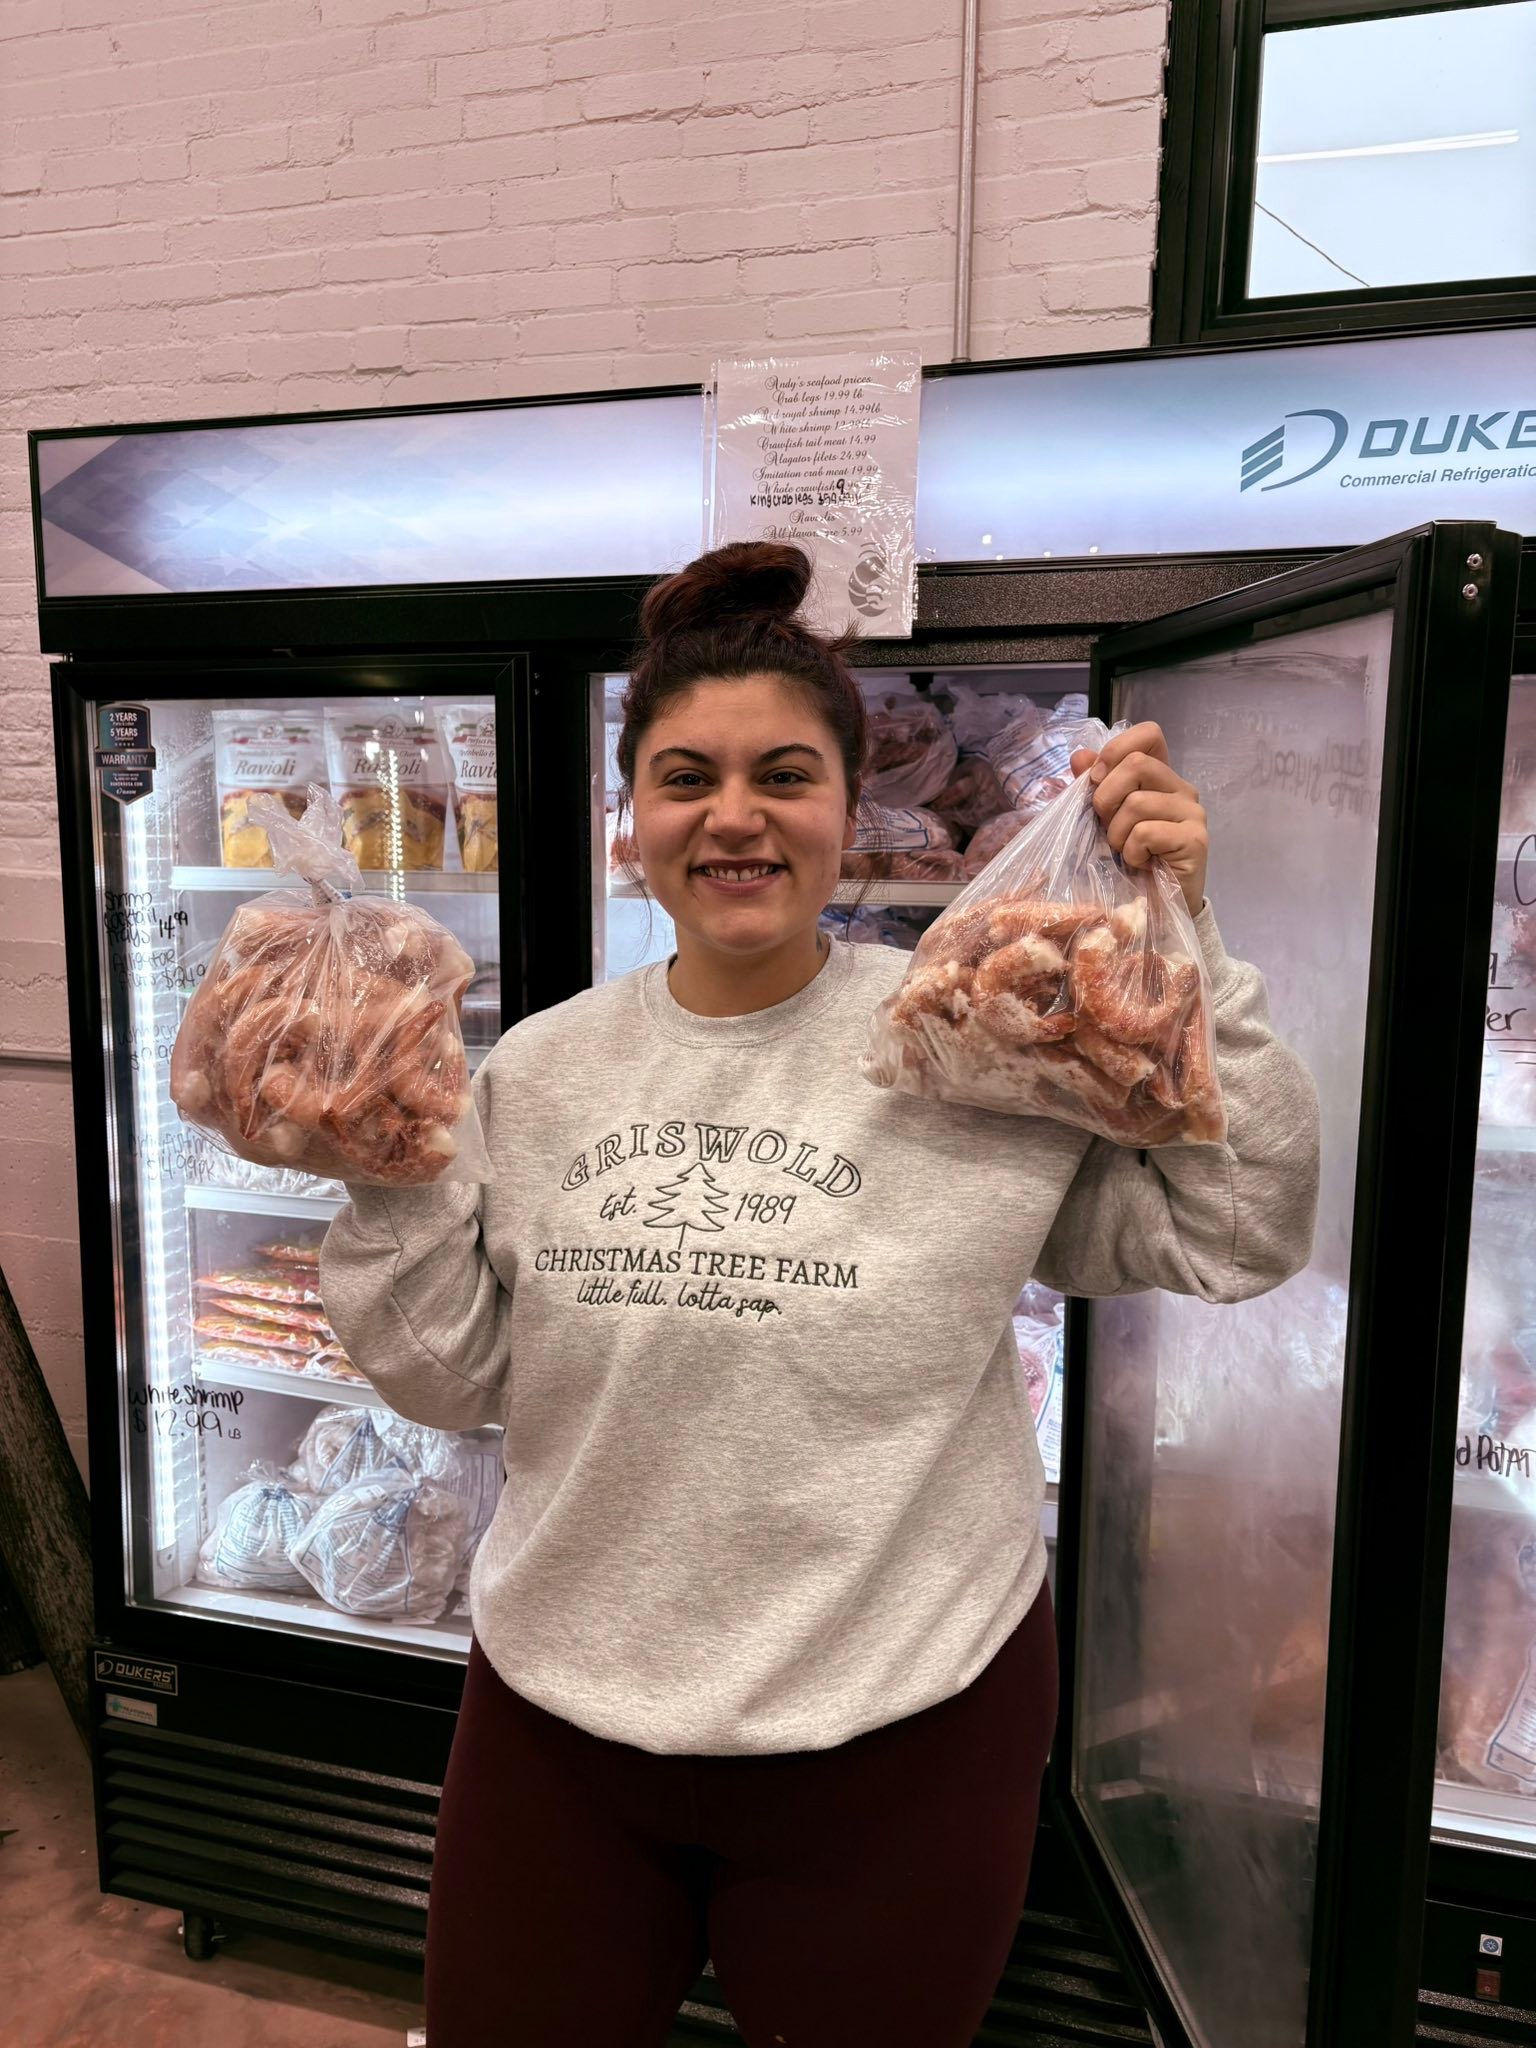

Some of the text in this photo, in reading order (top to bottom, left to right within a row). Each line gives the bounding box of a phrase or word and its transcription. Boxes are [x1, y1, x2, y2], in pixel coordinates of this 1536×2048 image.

[764, 375, 871, 392] Andy's seafood prices
[772, 388, 864, 405] Crab legs 19.99 lb
[782, 407, 807, 420] royal
[809, 405, 841, 420] shrimp
[763, 422, 797, 435] White
[799, 422, 831, 434] shrimp
[757, 434, 876, 452] Crawfish tail meat 14.99
[764, 450, 868, 466] Alagator filets 24.99
[752, 465, 879, 481] Imitation crab meat 19.99
[1339, 468, 1439, 488] Commercial
[757, 481, 794, 495] Whole
[795, 480, 836, 495] crawfish
[794, 492, 814, 506] legs
[762, 524, 786, 540] All
[788, 526, 822, 541] flavor
[840, 526, 863, 537] 5.99
[110, 712, 138, 722] 2 YEARS
[110, 728, 138, 737] 5 YEARS
[101, 754, 148, 765] WARRANTY
[234, 759, 296, 777] Ravioli
[353, 758, 421, 776] Raoli
[561, 1121, 862, 1199] GRISWOLD
[599, 1186, 797, 1225] Est. 1989
[534, 1248, 859, 1290] CHRISTMAS TREE FARM
[577, 1279, 783, 1323] little full. lotta sap.
[228, 1427, 243, 1440] LB
[115, 1662, 172, 1683] DUKERS
